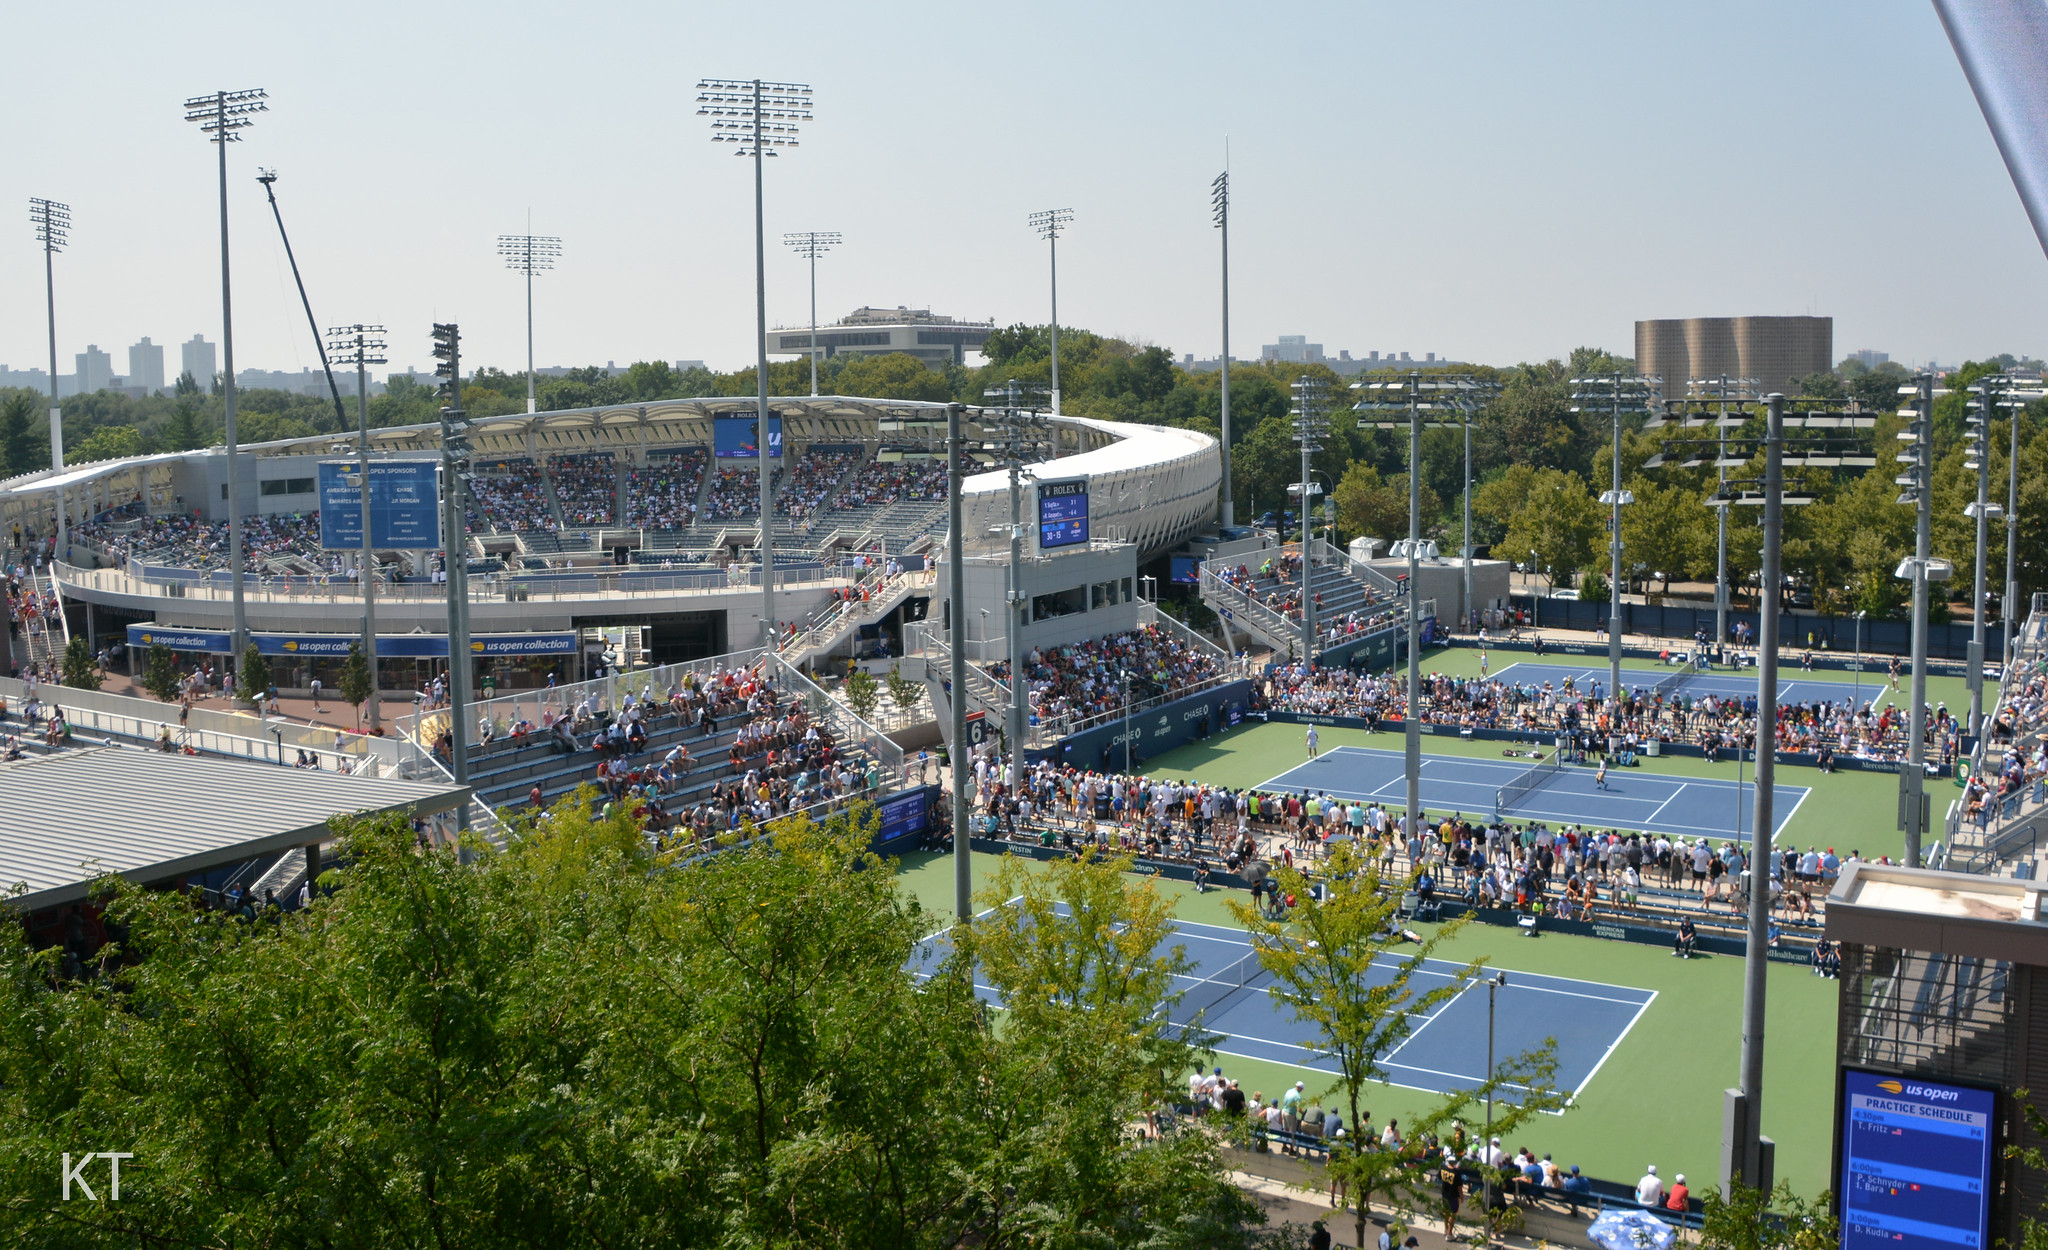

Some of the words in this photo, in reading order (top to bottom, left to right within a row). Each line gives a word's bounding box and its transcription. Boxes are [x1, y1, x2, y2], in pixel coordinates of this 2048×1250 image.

[1053, 485, 1076, 495] ROLEX
[1400, 580, 1405, 594] 6
[176, 637, 206, 646] collection
[310, 643, 330, 652] open
[499, 642, 524, 652] open
[525, 640, 569, 650] collection
[1184, 706, 1203, 721] CHASE
[971, 722, 982, 743] 6
[1862, 761, 1900, 771] Mercedes-B
[1008, 844, 1032, 854] WESTIN
[1592, 924, 1625, 934] AMERICAN
[1596, 930, 1625, 939] EXPRESS
[1767, 950, 1808, 961] dHealthcare
[1906, 1085, 1922, 1096] us
[1924, 1088, 1958, 1101] open
[1866, 1098, 1916, 1114] PRACTICE
[1919, 1106, 1972, 1122] SCHEDULE
[1854, 1110, 1884, 1122] 4:30pm
[1970, 1129, 1981, 1137] P4
[1858, 1122, 1866, 1130] T.
[1868, 1123, 1888, 1134] Fritz
[1852, 1162, 1882, 1174] 6:00pm
[1968, 1182, 1979, 1191] P4
[1858, 1174, 1865, 1182] P.
[1868, 1175, 1906, 1189] Schnyder
[1865, 1183, 1884, 1193] Bara
[1855, 1225, 1863, 1233] D.
[1866, 1227, 1888, 1238] Kudla
[1966, 1234, 1976, 1243] P4
